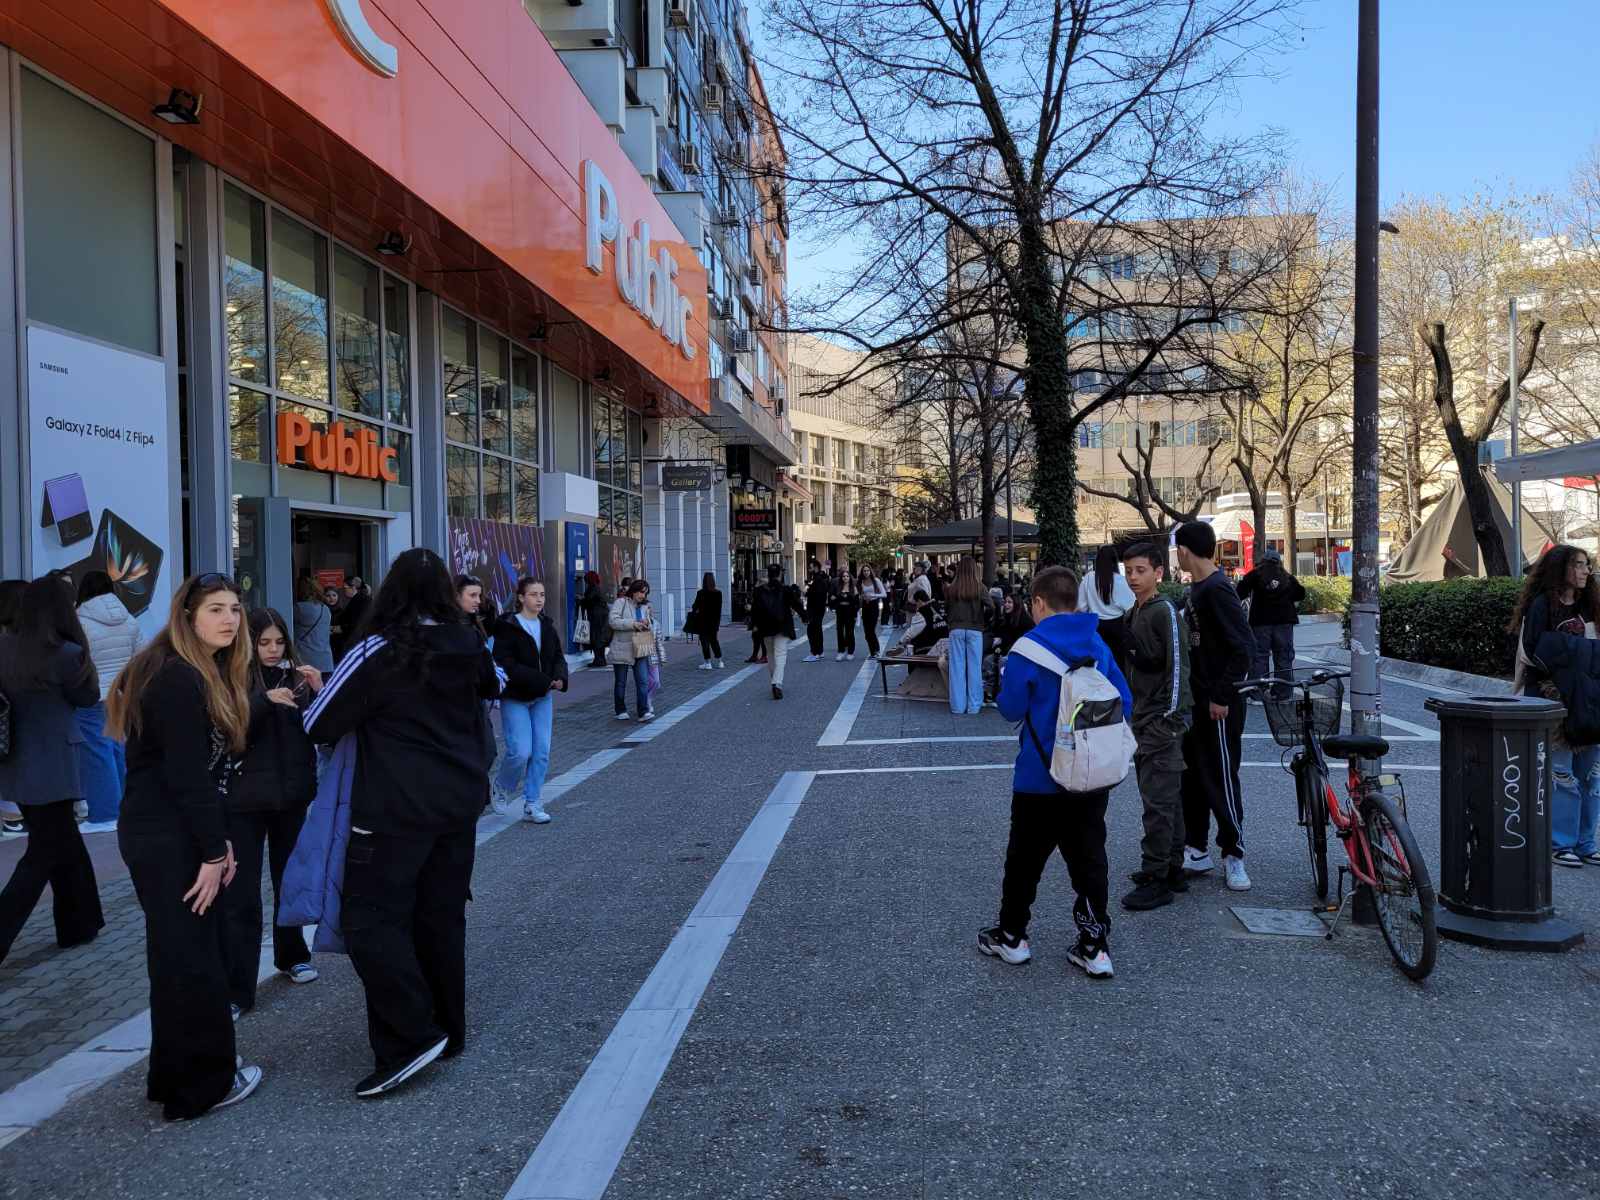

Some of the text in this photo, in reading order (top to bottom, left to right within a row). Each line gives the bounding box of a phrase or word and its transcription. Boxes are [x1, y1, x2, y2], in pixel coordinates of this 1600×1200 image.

[581, 160, 694, 361] Public
[40, 362, 69, 375] SAMSUNG
[45, 416, 85, 437] Galaxy
[86, 423, 92, 436] Z
[94, 425, 121, 441] Fold4
[126, 430, 132, 443] Z
[133, 431, 154, 448] Flip4
[277, 412, 398, 482] Public
[671, 478, 703, 488] Gallery
